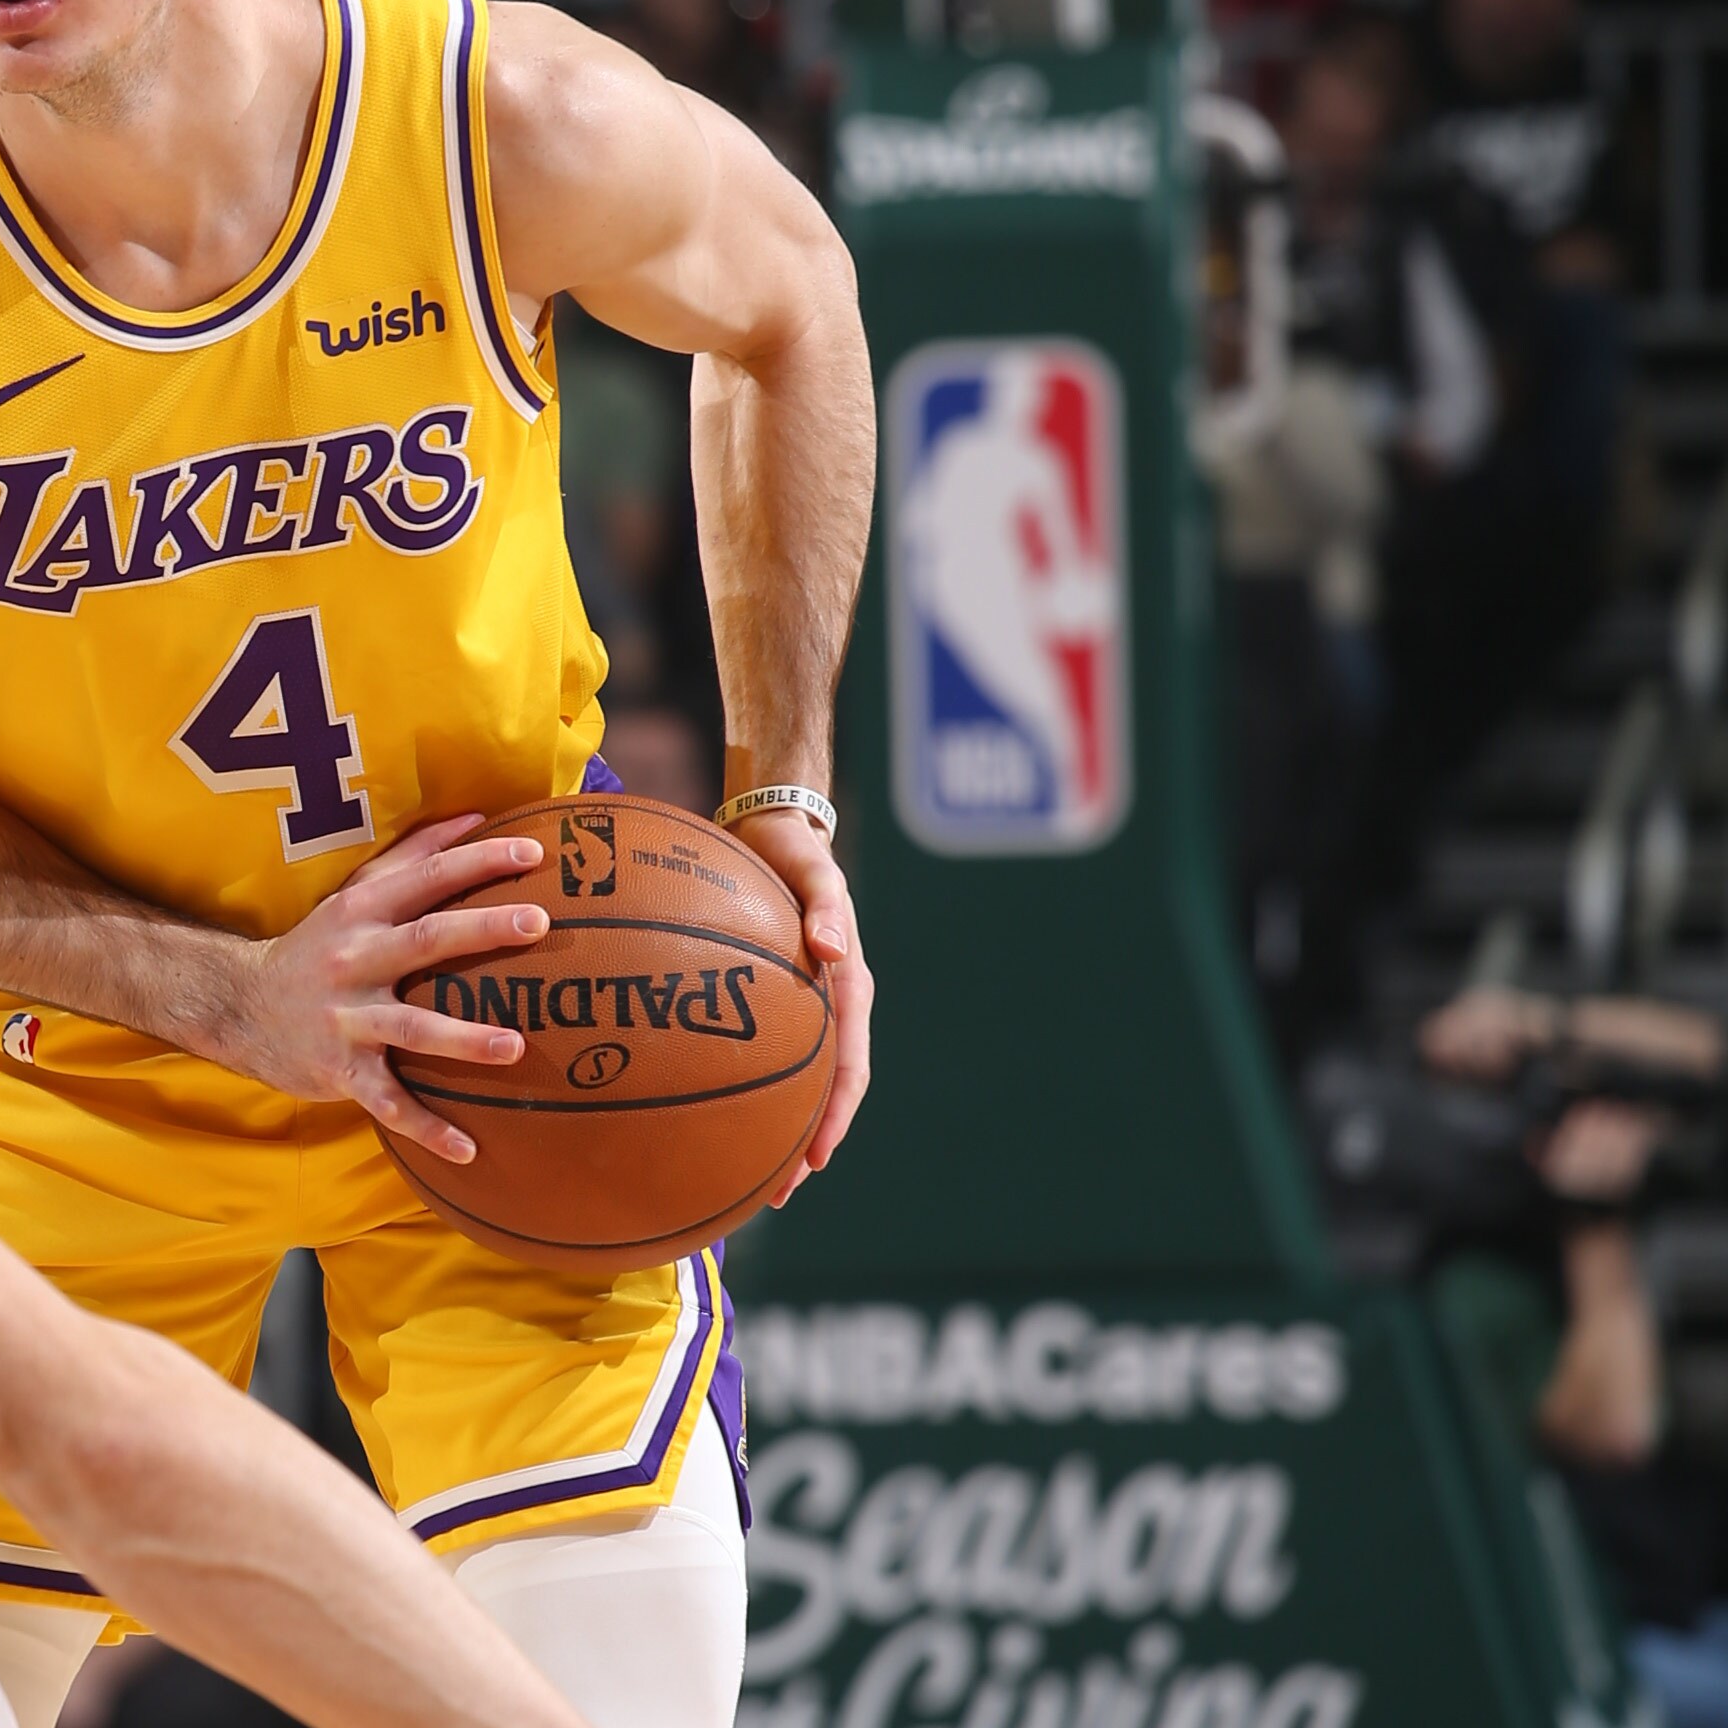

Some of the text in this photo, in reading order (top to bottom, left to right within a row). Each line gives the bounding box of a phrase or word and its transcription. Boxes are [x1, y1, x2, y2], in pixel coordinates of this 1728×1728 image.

[305, 289, 446, 357] wish
[167, 605, 376, 865] 4
[580, 815, 609, 828] NBA
[736, 789, 800, 814] HUMBLE
[806, 793, 834, 827] OVER
[631, 849, 658, 867] BALL
[433, 964, 757, 1041] SPALDING
[743, 1430, 1296, 1678] Season
